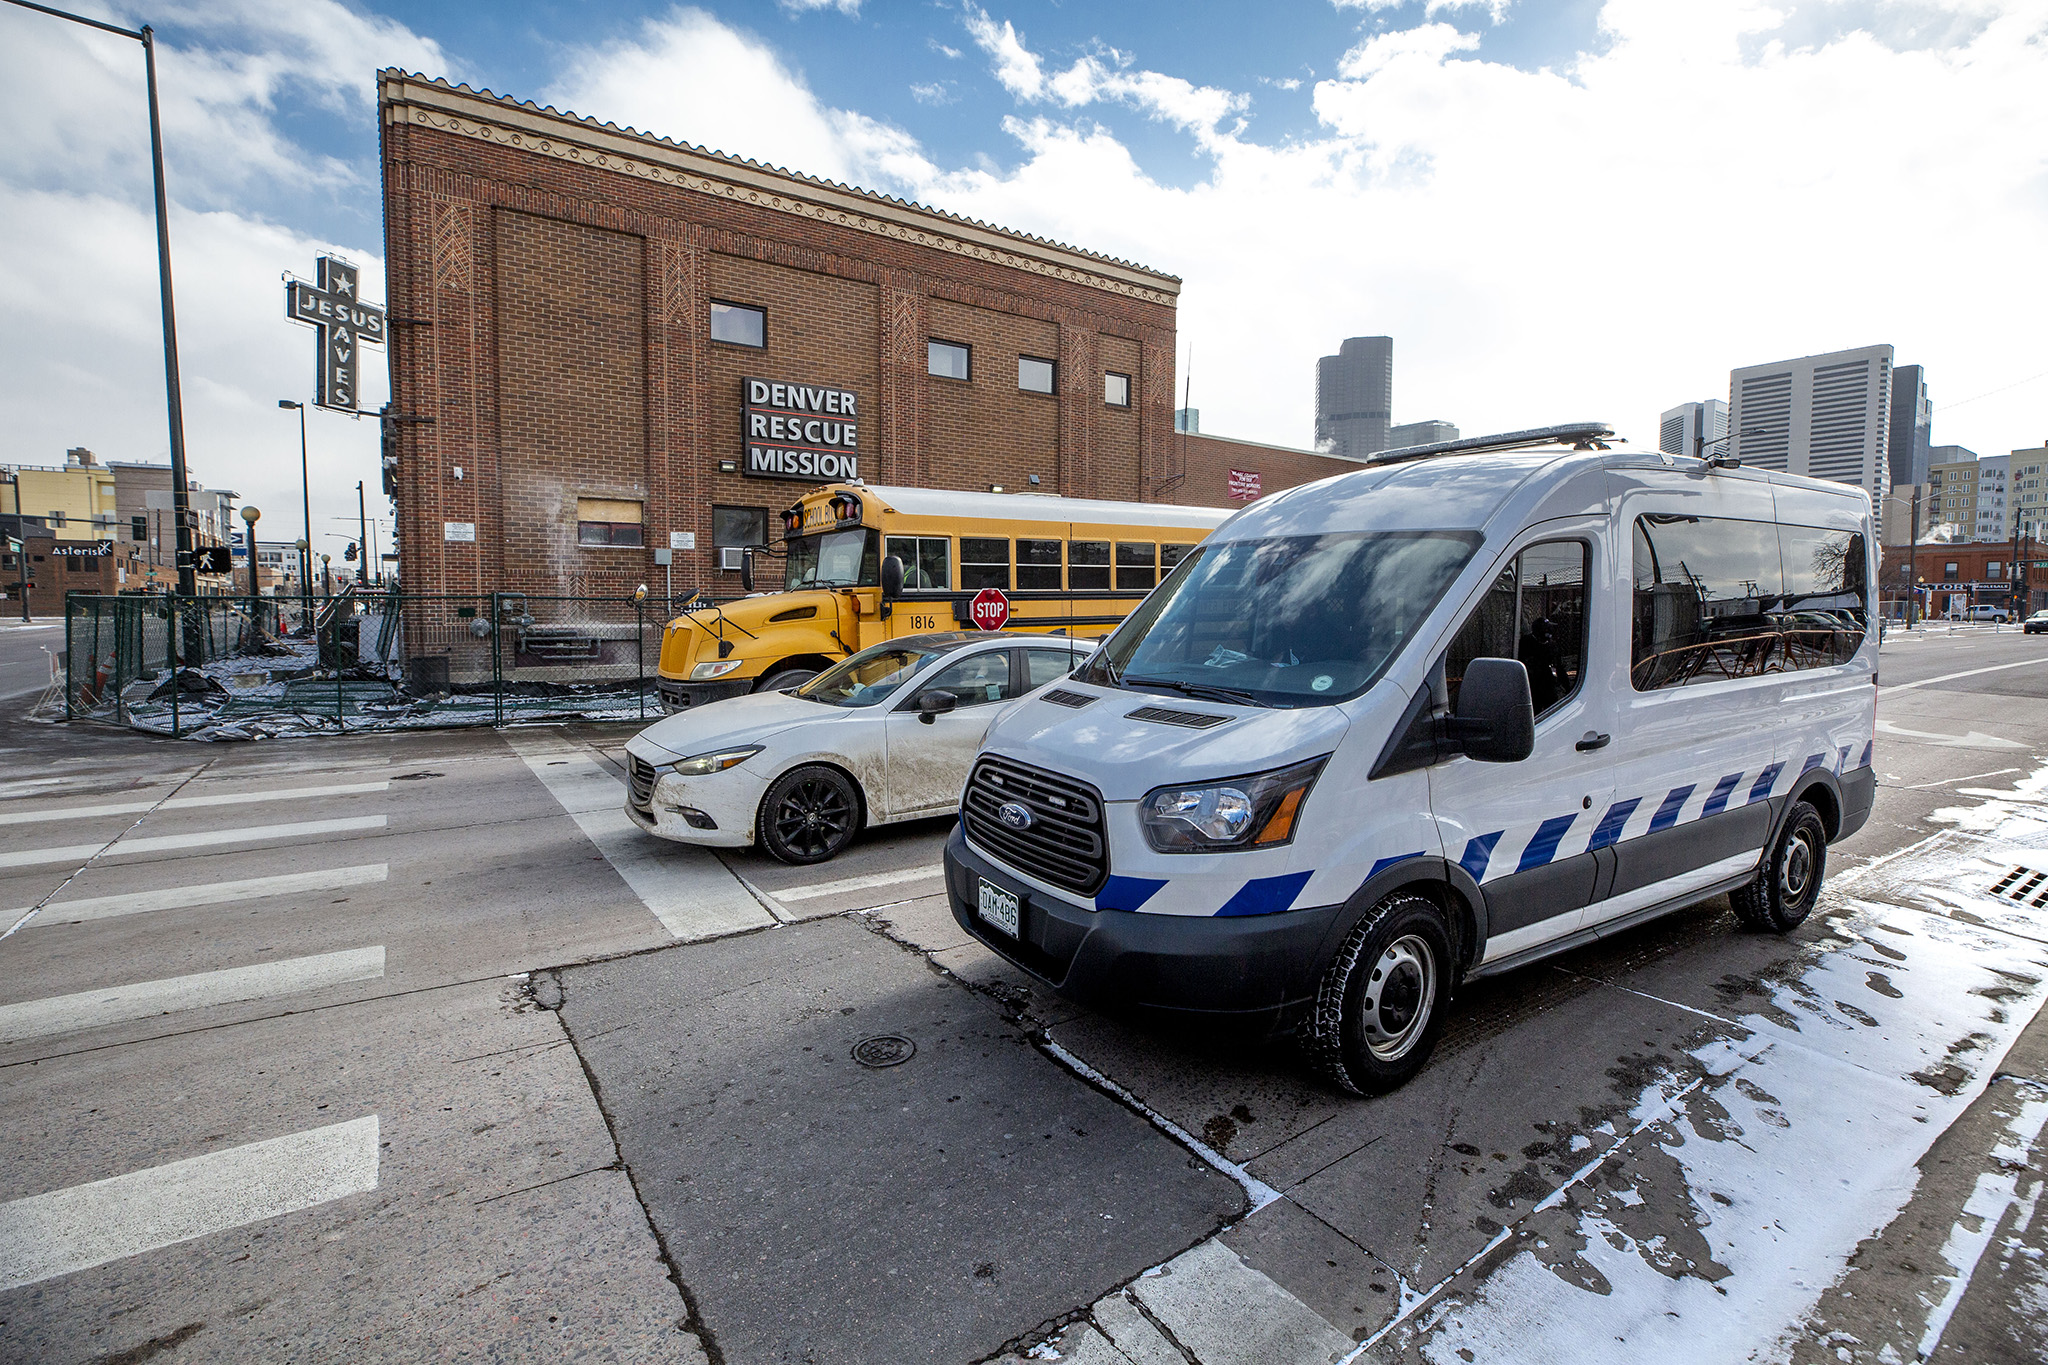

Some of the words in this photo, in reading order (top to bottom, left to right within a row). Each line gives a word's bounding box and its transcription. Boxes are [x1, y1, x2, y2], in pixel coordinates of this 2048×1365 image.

[301, 294, 381, 332] JESUS
[750, 380, 856, 415] DENVER
[751, 413, 856, 446] RESCUE
[751, 448, 857, 478] MISSION
[803, 506, 824, 528] SCHOOL
[51, 545, 104, 556] Asterisk
[977, 602, 1004, 618] STOP
[910, 616, 935, 629] 1816
[1002, 807, 1020, 825] Ford
